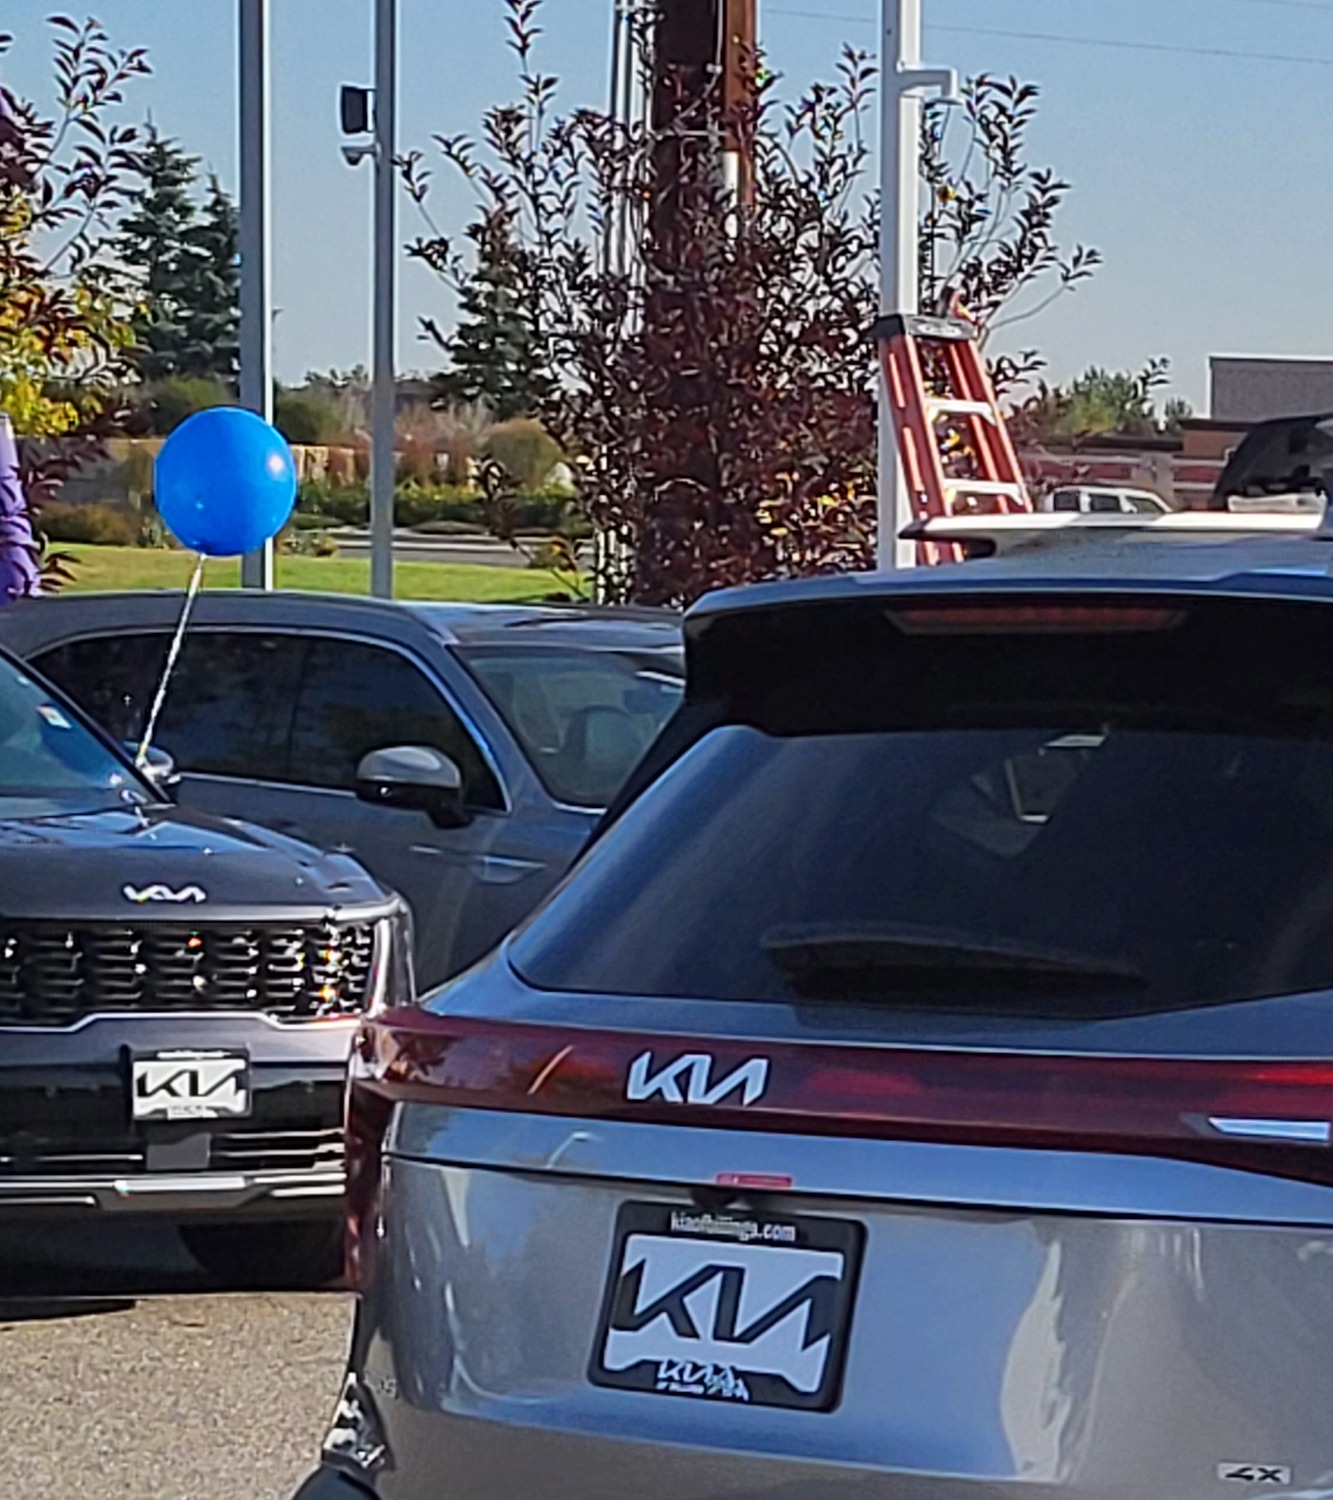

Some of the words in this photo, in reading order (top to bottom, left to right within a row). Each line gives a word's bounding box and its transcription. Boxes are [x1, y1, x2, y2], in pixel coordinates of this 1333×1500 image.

[123, 885, 206, 903] KIA
[136, 1069, 248, 1099] KIA
[626, 1051, 769, 1107] KIA
[611, 1257, 841, 1352] KIA
